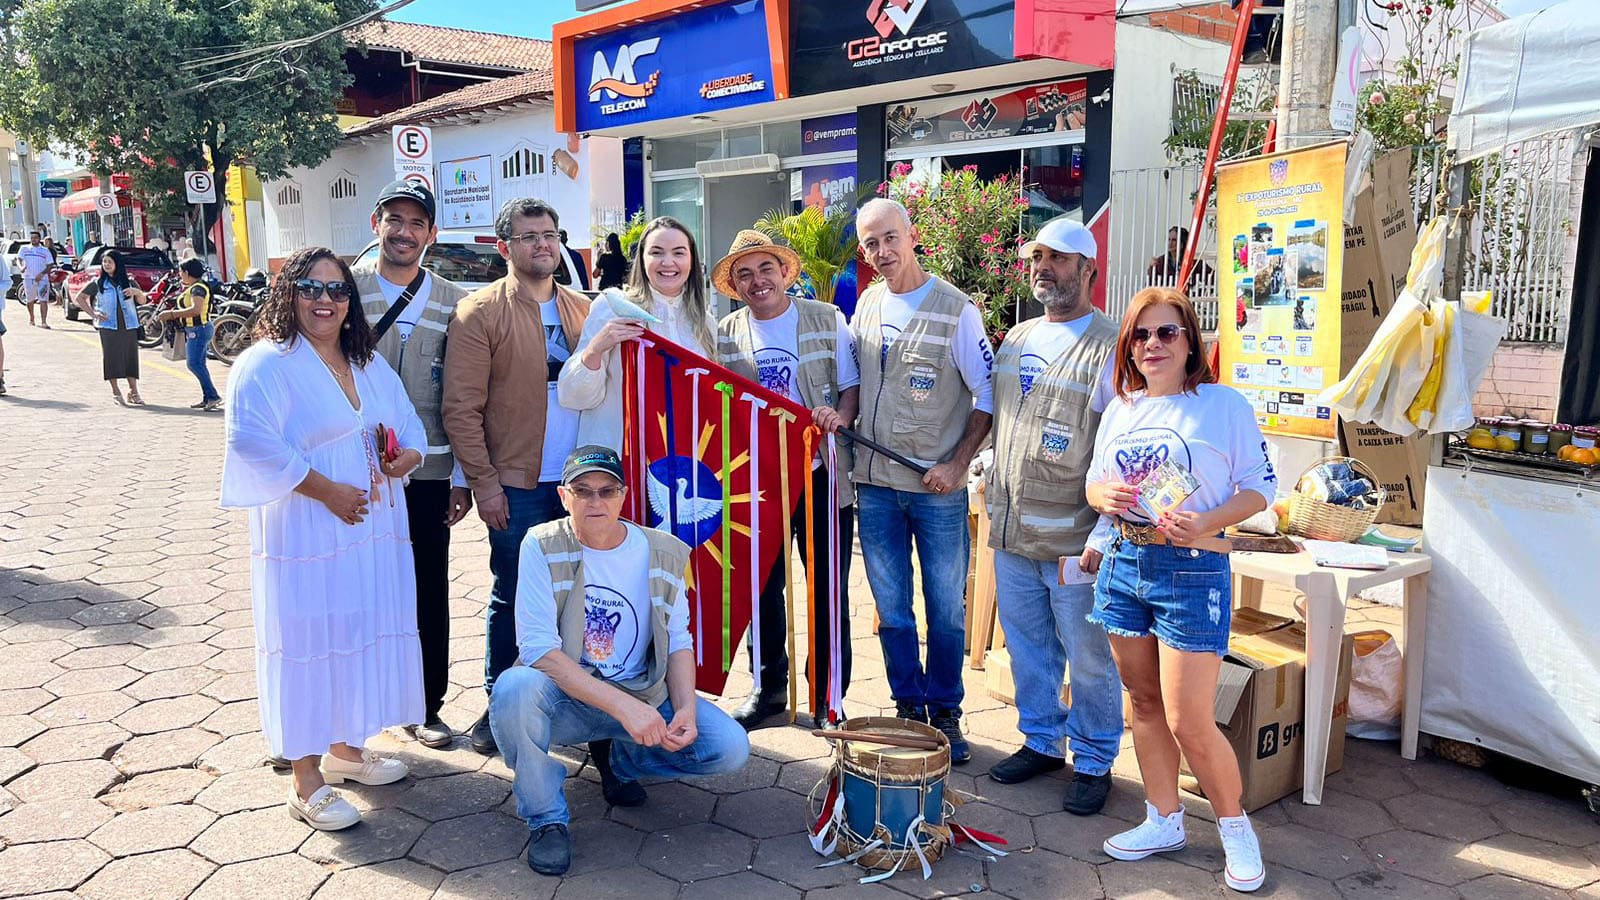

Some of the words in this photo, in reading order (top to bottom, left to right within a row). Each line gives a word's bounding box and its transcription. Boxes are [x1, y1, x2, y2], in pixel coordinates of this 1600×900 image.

[905, 51, 914, 59] EM
[600, 98, 646, 115] TELECOM
[406, 133, 419, 153] E
[195, 176, 205, 189] E
[1295, 182, 1323, 194] RURAL
[1345, 240, 1356, 249] EM
[772, 356, 791, 364] RURAL
[1364, 439, 1382, 447] CAIXA
[602, 599, 625, 608] RURAL
